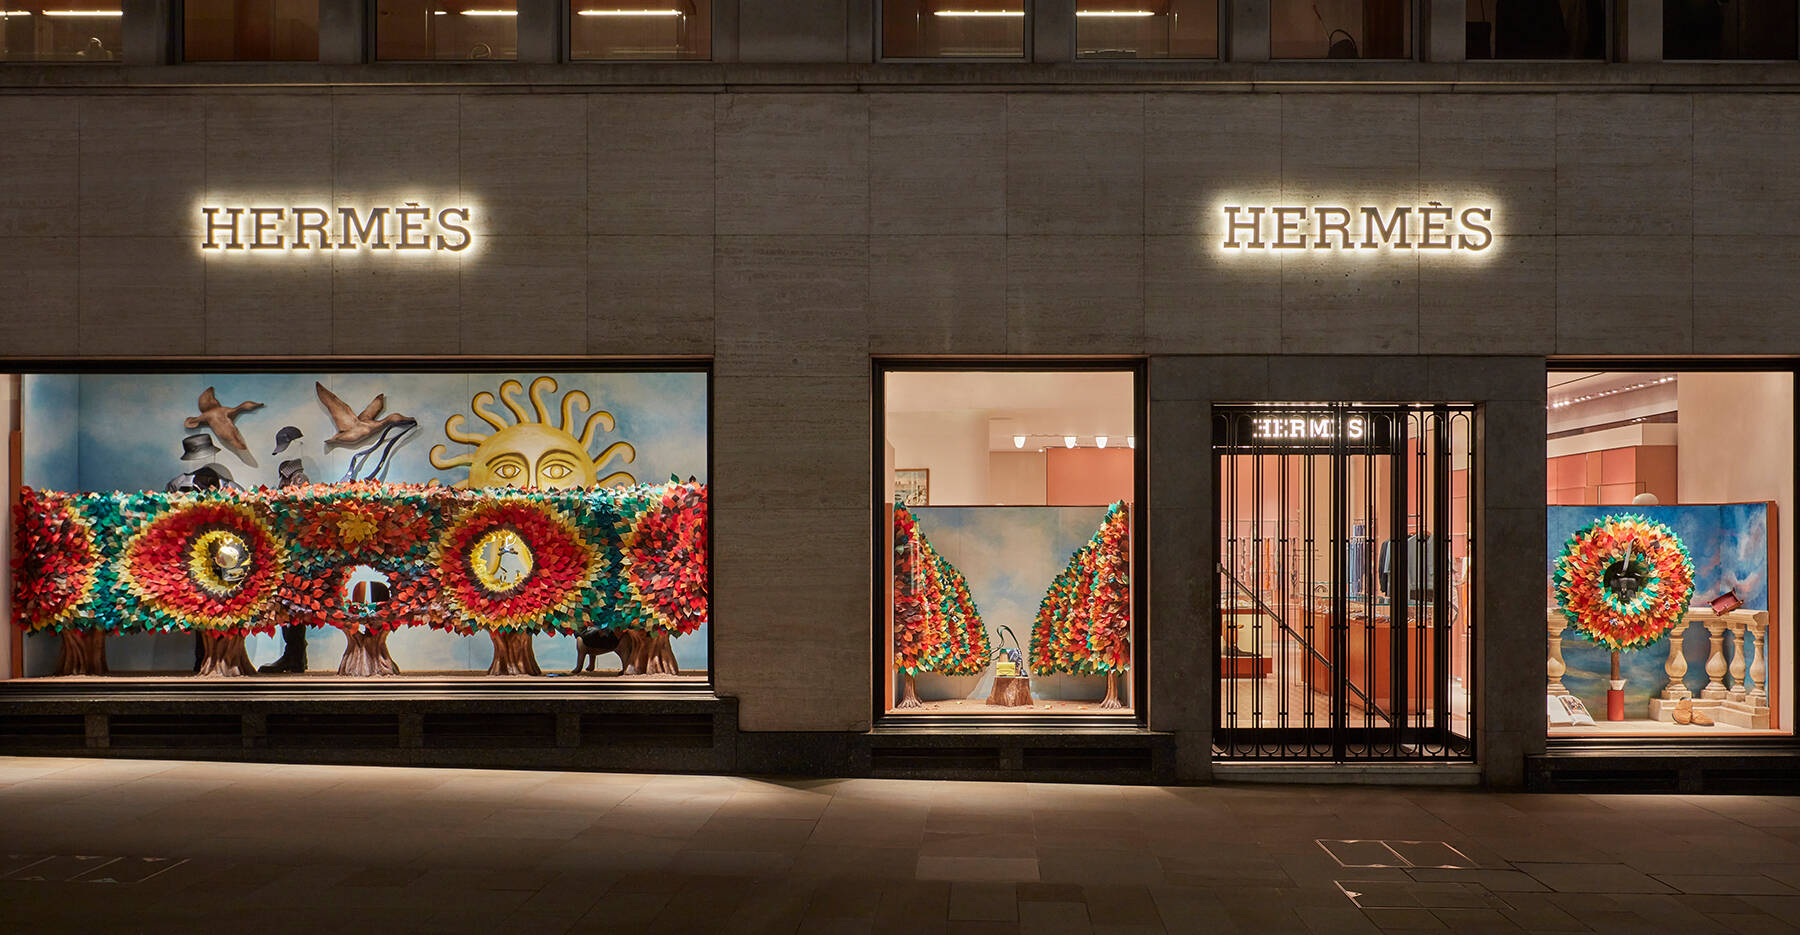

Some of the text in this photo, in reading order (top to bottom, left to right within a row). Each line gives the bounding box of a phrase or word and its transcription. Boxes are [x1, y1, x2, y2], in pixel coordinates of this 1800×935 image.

[202, 202, 471, 251] HERMÈS
[1223, 201, 1492, 251] HERMÈS
[1253, 418, 1363, 438] HERMS
